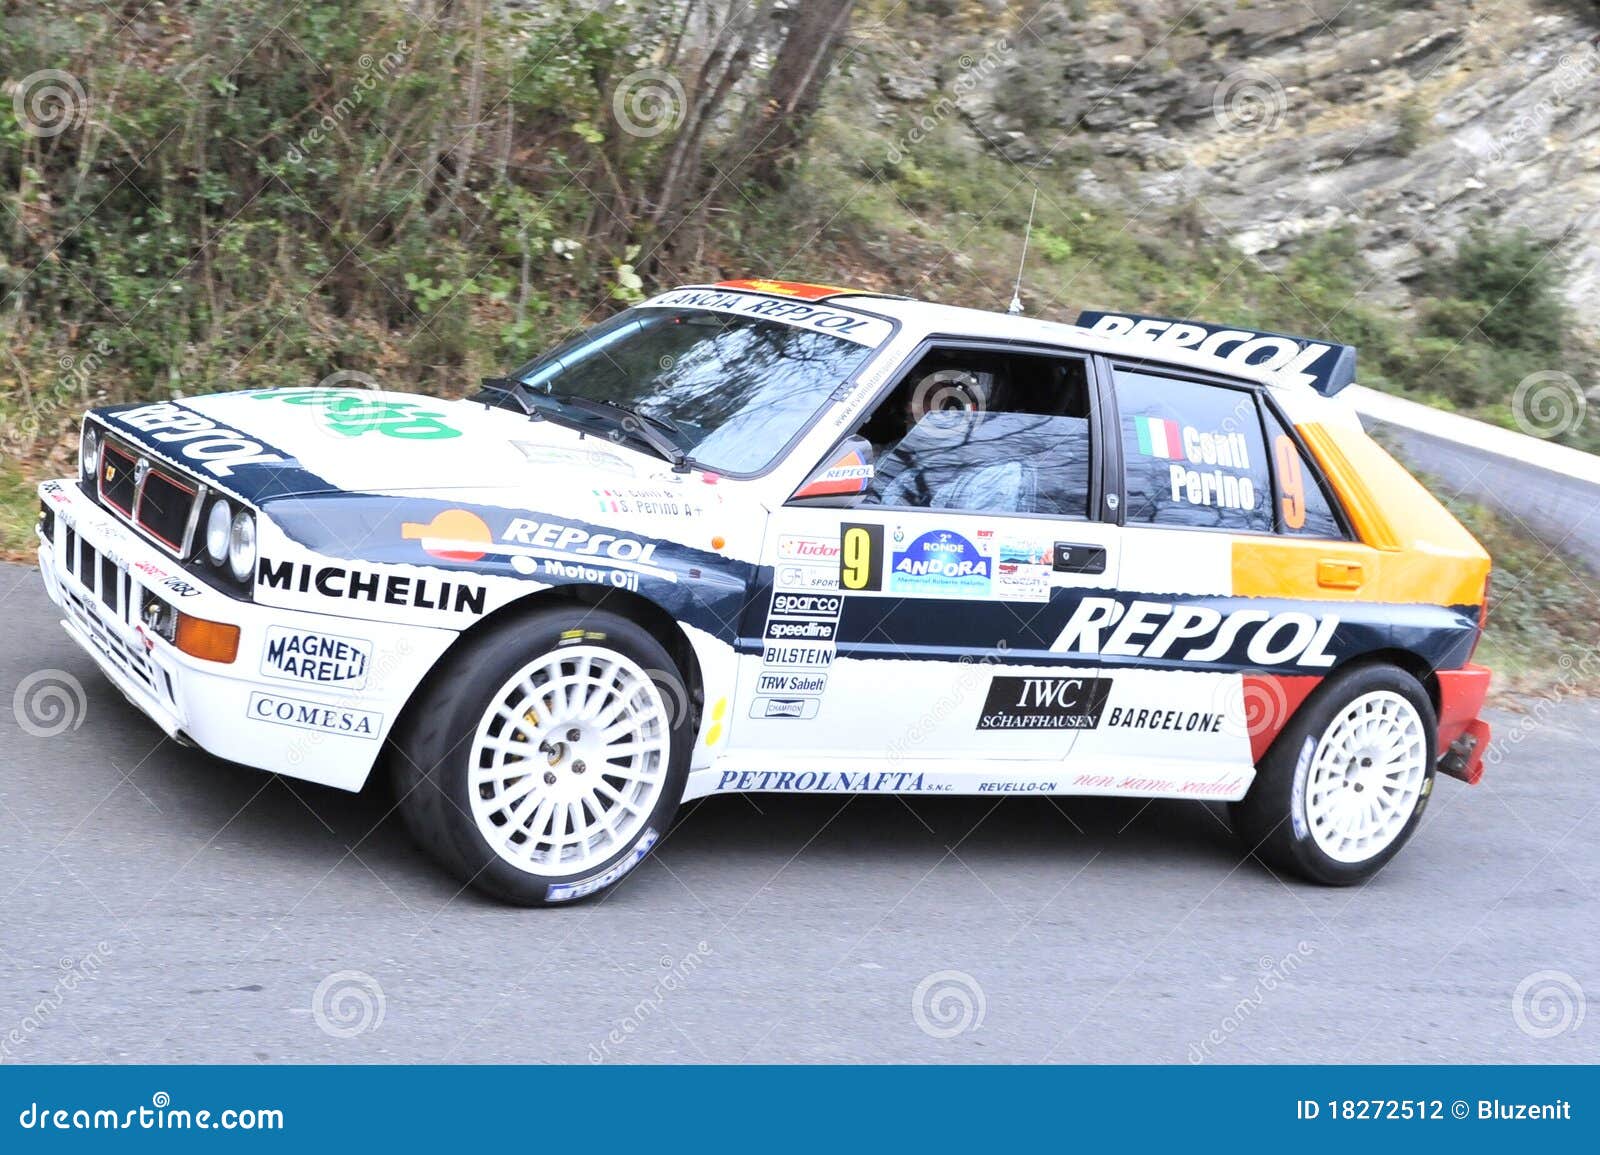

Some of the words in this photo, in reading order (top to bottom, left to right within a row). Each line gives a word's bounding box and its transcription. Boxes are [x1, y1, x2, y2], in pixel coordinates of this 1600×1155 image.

[656, 292, 736, 309] LANCIA
[743, 299, 869, 334] REPSOL
[108, 403, 284, 477] REPSOL
[827, 468, 871, 478] REPSOL
[1274, 434, 1305, 529] 9
[1169, 465, 1255, 511] Perino
[637, 500, 679, 516] Perino
[502, 518, 658, 566] REPSOL
[796, 541, 840, 557] Tudor
[923, 542, 965, 553] RONDE
[843, 528, 871, 590] 9
[896, 557, 987, 578] ANDORA
[258, 557, 486, 615] MICHELIN
[545, 560, 605, 584] Motor
[610, 568, 640, 592] Oil
[775, 595, 839, 613] sparco
[769, 622, 832, 638] speedline
[1049, 597, 1341, 667] REPSOL
[765, 647, 832, 664] BILSTEIN
[761, 676, 789, 690] TRW
[790, 677, 824, 691] Sabelt
[1016, 679, 1082, 707] IWC
[256, 698, 373, 734] COMESA
[769, 704, 801, 713] CHAMPION
[981, 713, 1097, 729] SCHAFFHAUSEN
[1108, 707, 1225, 733] BARCELONE
[716, 770, 925, 791] PETROLNAFTA
[927, 783, 955, 792] S.N.C.
[978, 782, 1057, 792] REVELLO-CN
[1073, 774, 1114, 787] non
